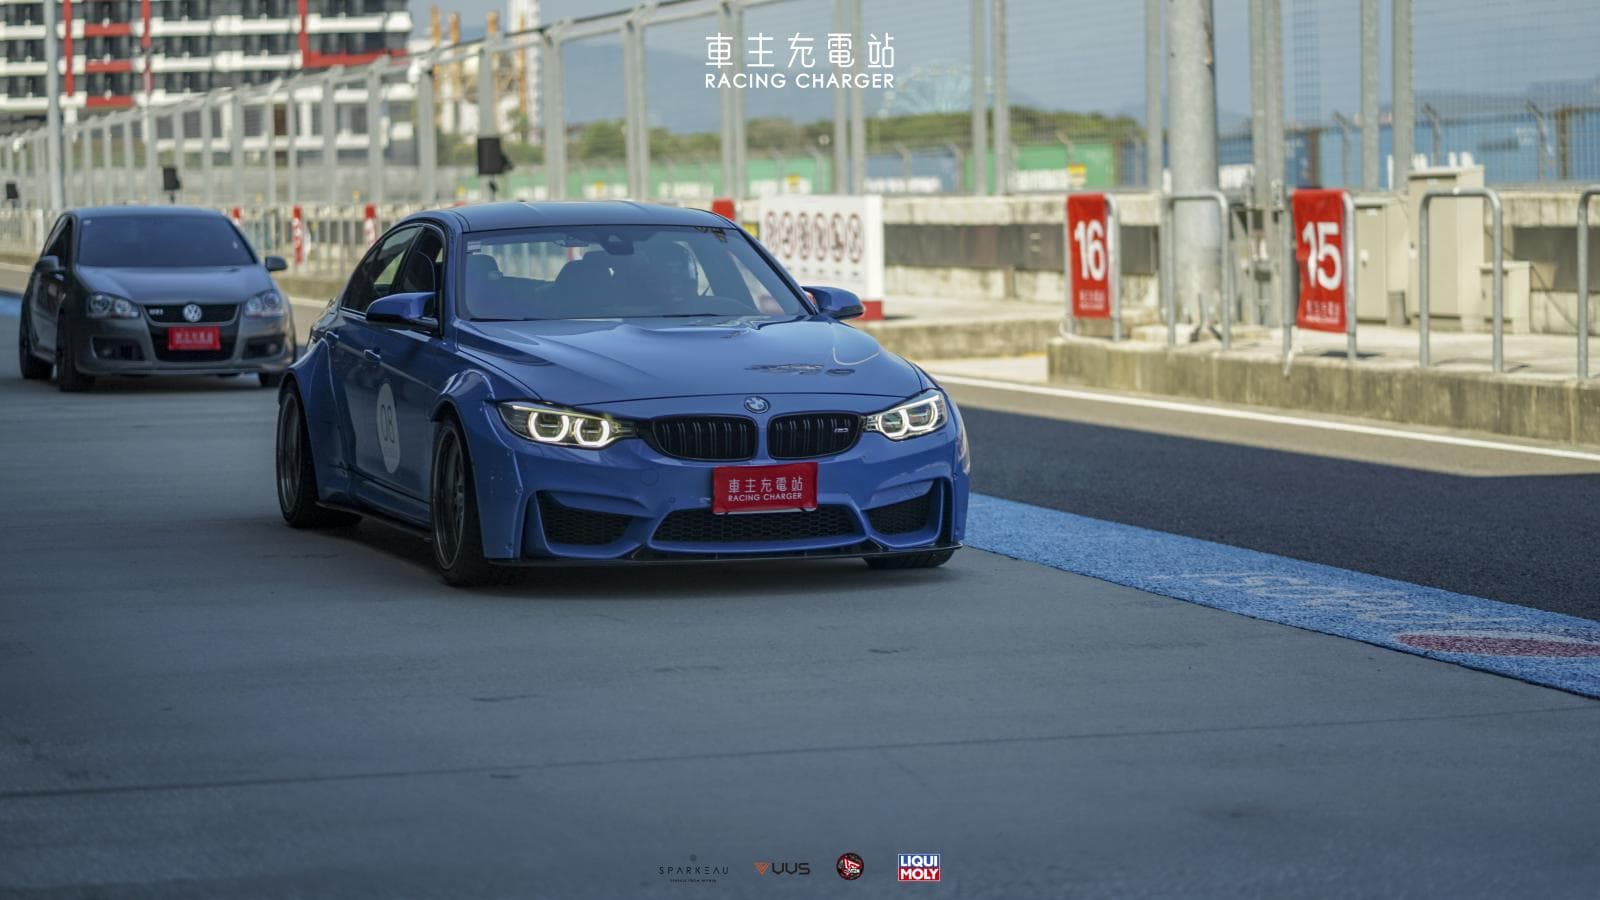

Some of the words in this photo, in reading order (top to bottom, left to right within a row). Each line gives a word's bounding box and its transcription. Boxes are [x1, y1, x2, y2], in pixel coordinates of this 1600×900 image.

[1074, 219, 1106, 281] 16
[1302, 221, 1342, 290] 15
[728, 476, 803, 493] 車主充電站
[728, 493, 761, 502] RACING
[763, 492, 802, 501] CHARGER
